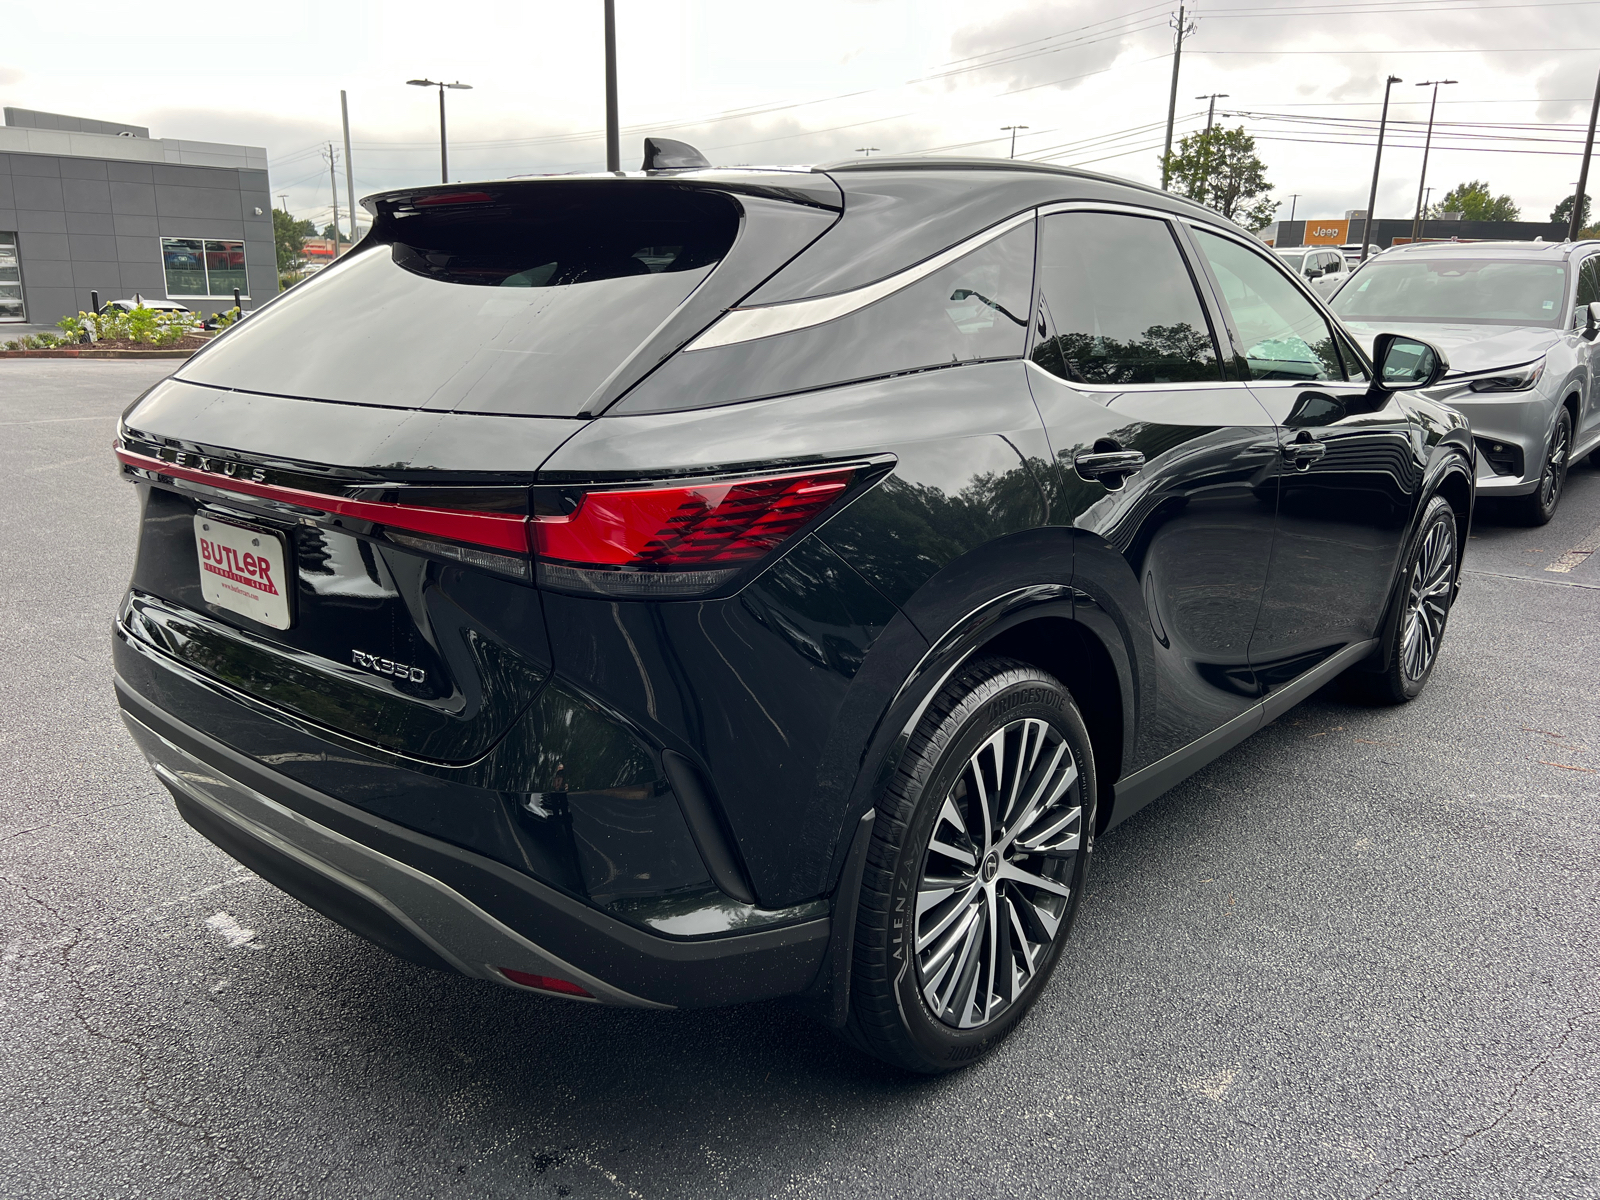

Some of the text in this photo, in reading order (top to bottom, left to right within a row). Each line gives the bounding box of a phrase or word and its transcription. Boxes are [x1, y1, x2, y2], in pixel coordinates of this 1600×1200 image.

[1313, 226, 1339, 239] Jeep
[155, 447, 267, 483] LEXUS
[987, 688, 1066, 721] BRIDGESTONE
[893, 860, 914, 960] ALENZA
